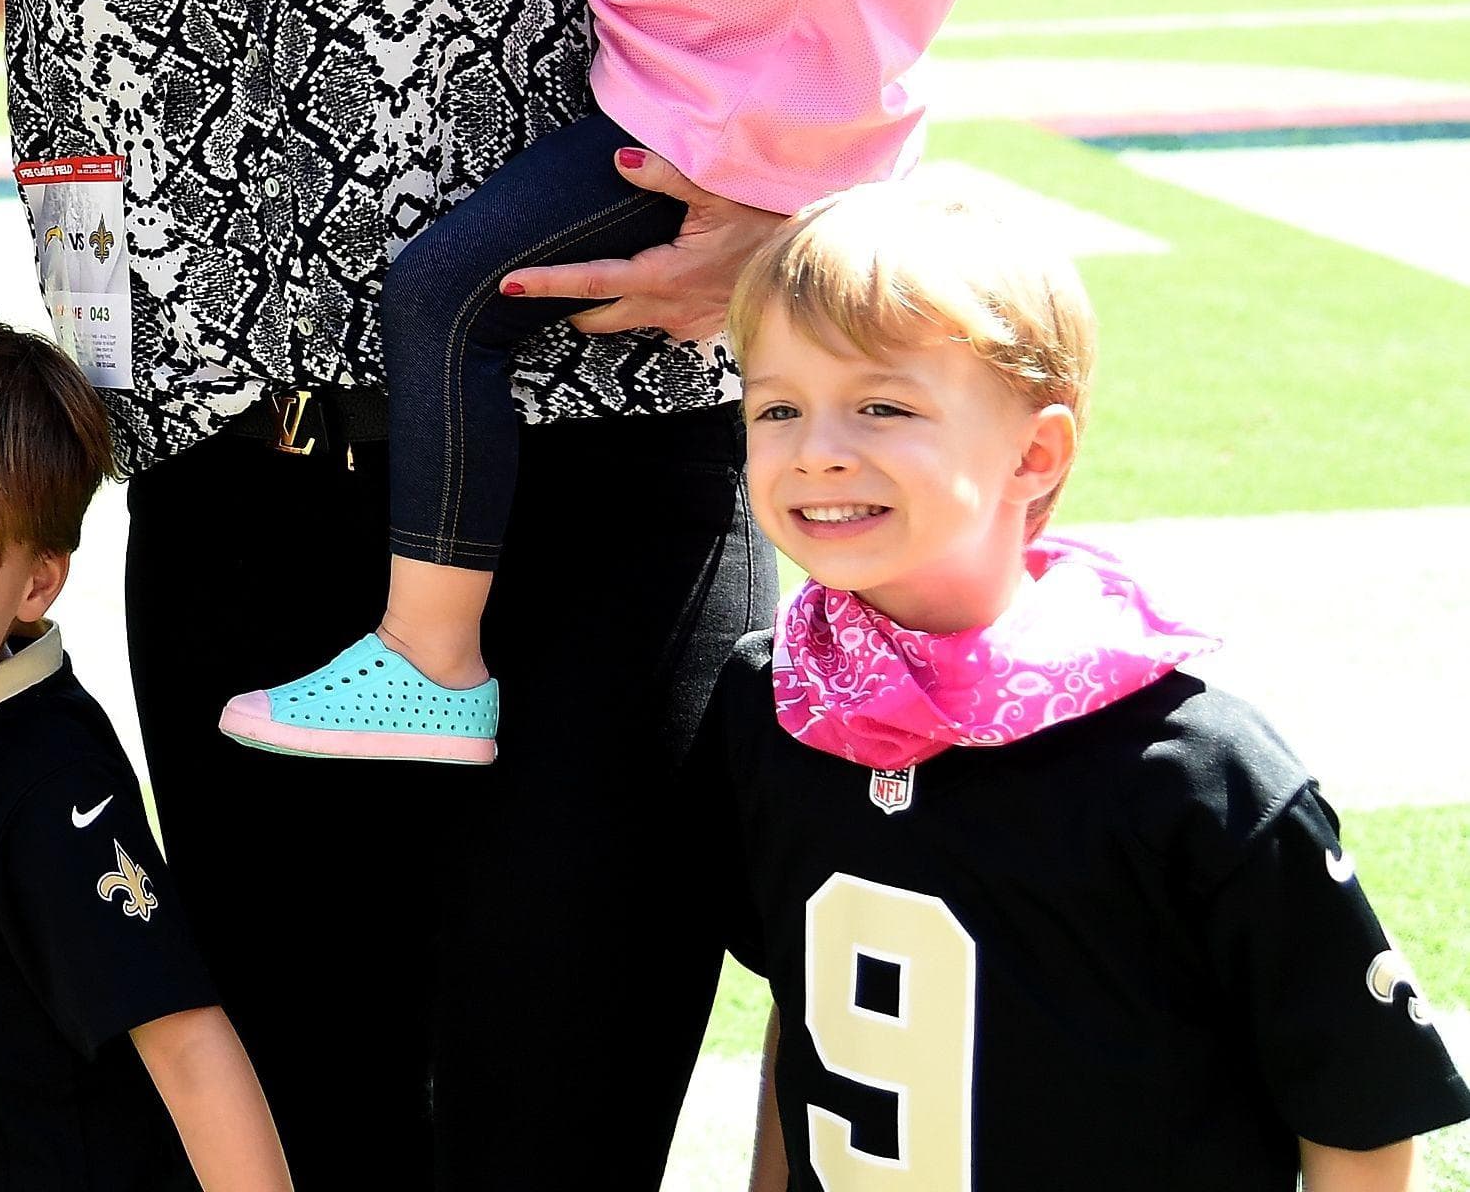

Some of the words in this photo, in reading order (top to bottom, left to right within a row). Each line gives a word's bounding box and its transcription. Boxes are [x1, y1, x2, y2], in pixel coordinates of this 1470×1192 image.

[68, 232, 85, 252] VS
[90, 306, 110, 322] 043
[874, 779, 904, 803] NFL
[805, 871, 976, 1192] 9
